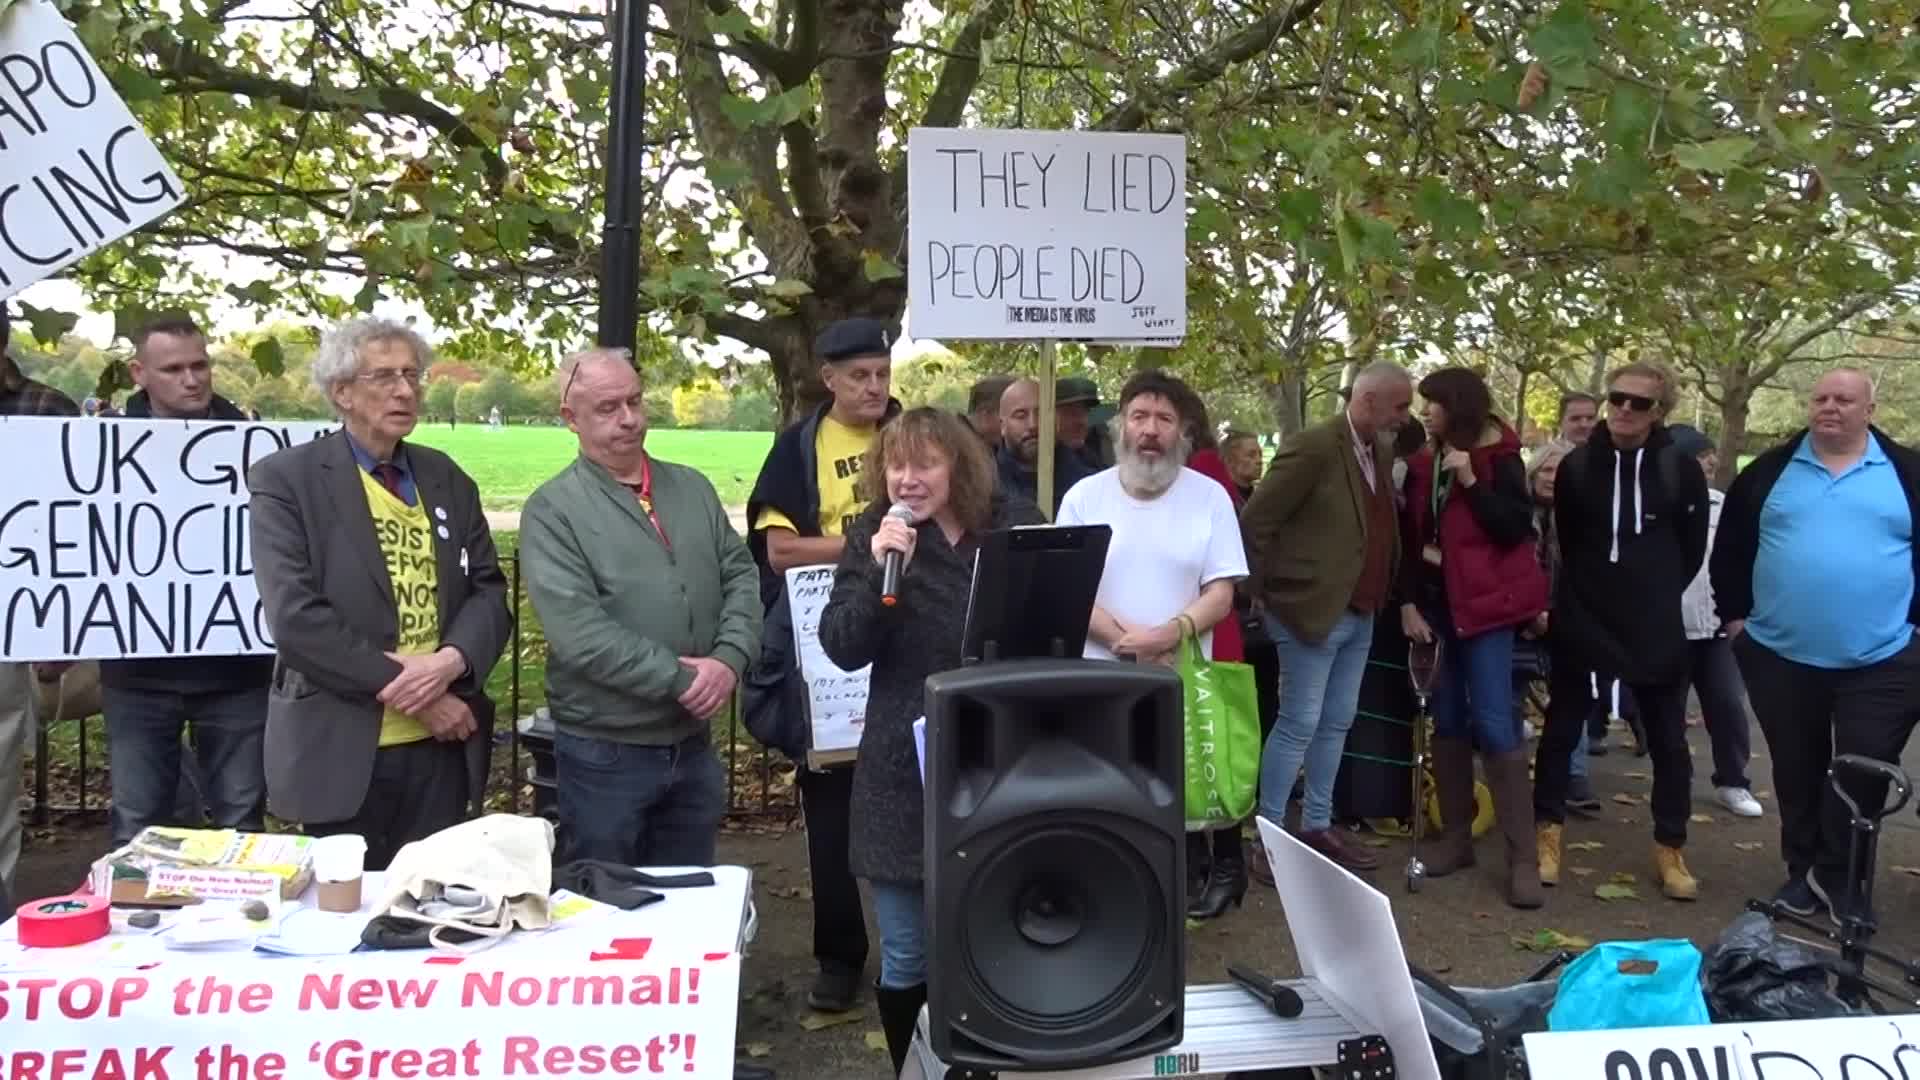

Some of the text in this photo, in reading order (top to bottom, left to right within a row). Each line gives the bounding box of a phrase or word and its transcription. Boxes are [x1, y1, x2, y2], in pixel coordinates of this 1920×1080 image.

[0, 125, 179, 286] CING
[935, 148, 1176, 213] THEY LIED
[928, 240, 1145, 305] PEOPLE DIED
[1009, 306, 1023, 322] THE
[1024, 306, 1048, 323] MEDIA
[1059, 307, 1073, 323] THE
[1074, 308, 1096, 323] VIRUS
[62, 422, 157, 495] UK
[172, 975, 274, 1017] the
[298, 972, 439, 1012] New
[462, 967, 701, 1008] Normal!
[0, 1046, 174, 1080] REAK
[196, 1042, 286, 1080] the
